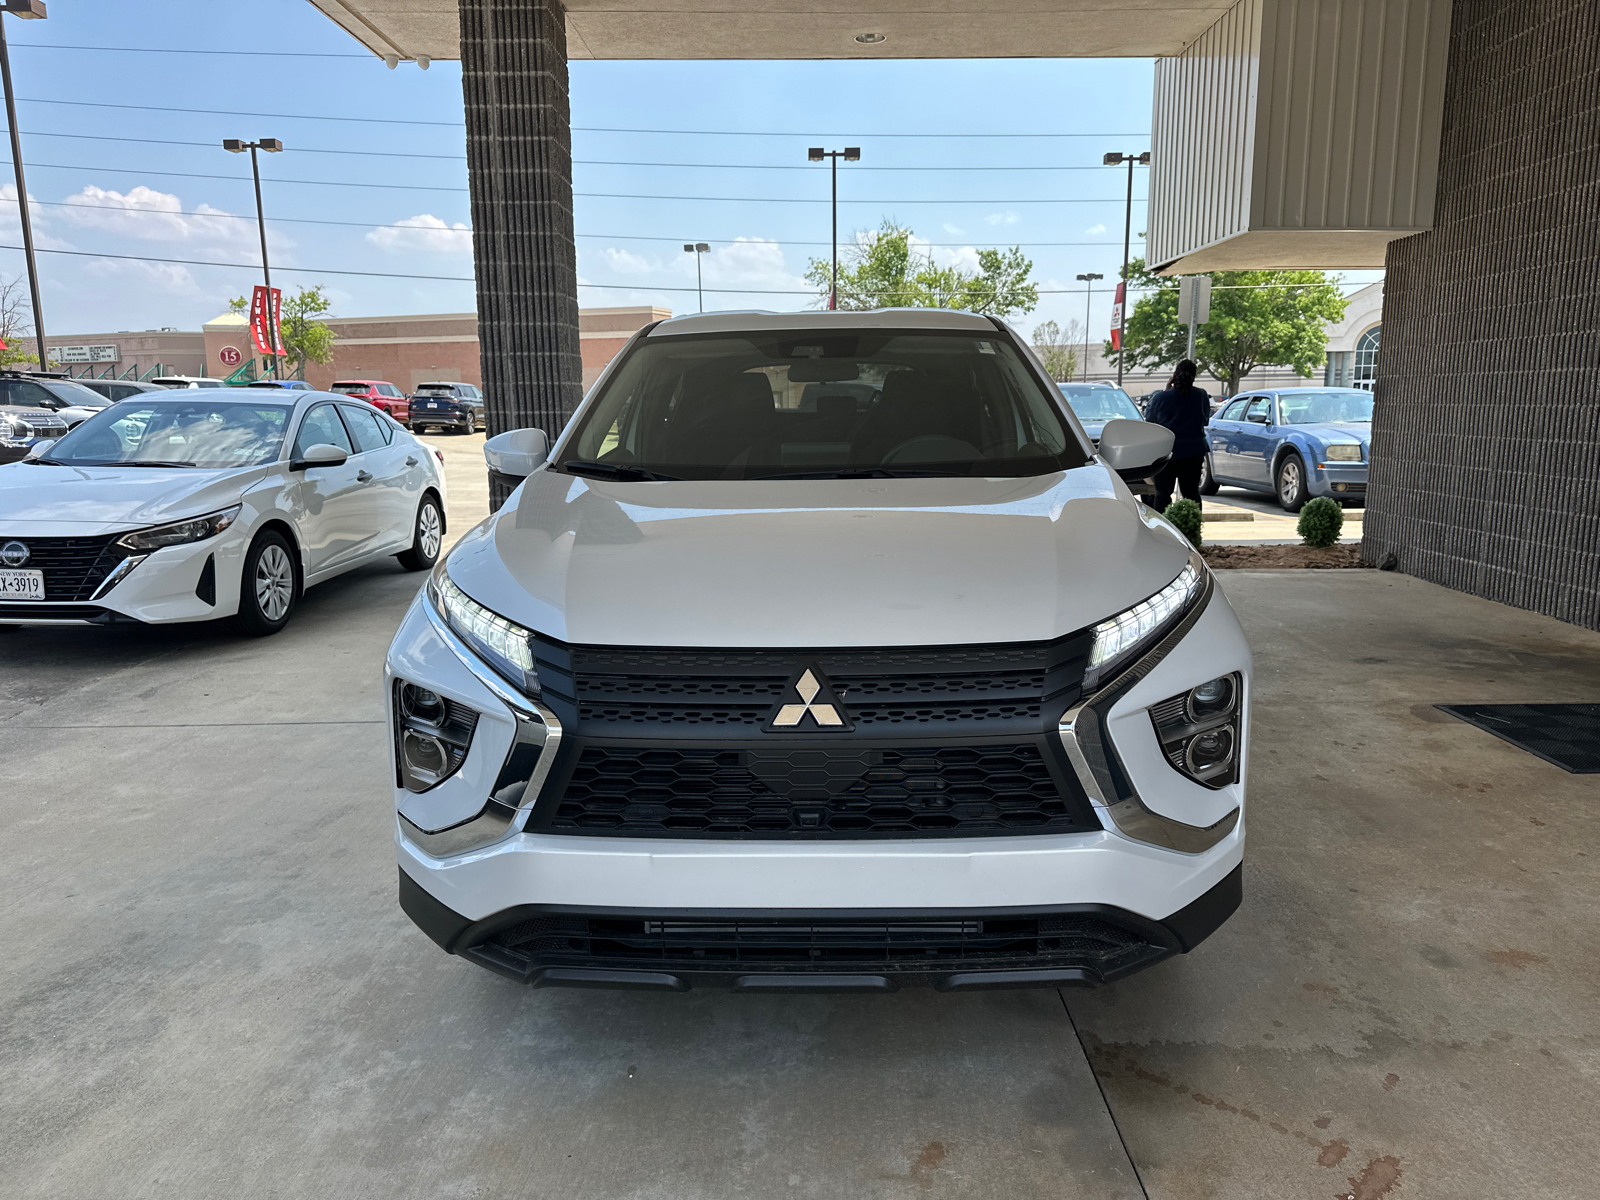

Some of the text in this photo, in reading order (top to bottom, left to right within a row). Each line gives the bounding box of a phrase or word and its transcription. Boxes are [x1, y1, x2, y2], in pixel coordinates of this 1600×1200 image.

[254, 290, 266, 349] NEW CARS
[224, 351, 237, 362] 15
